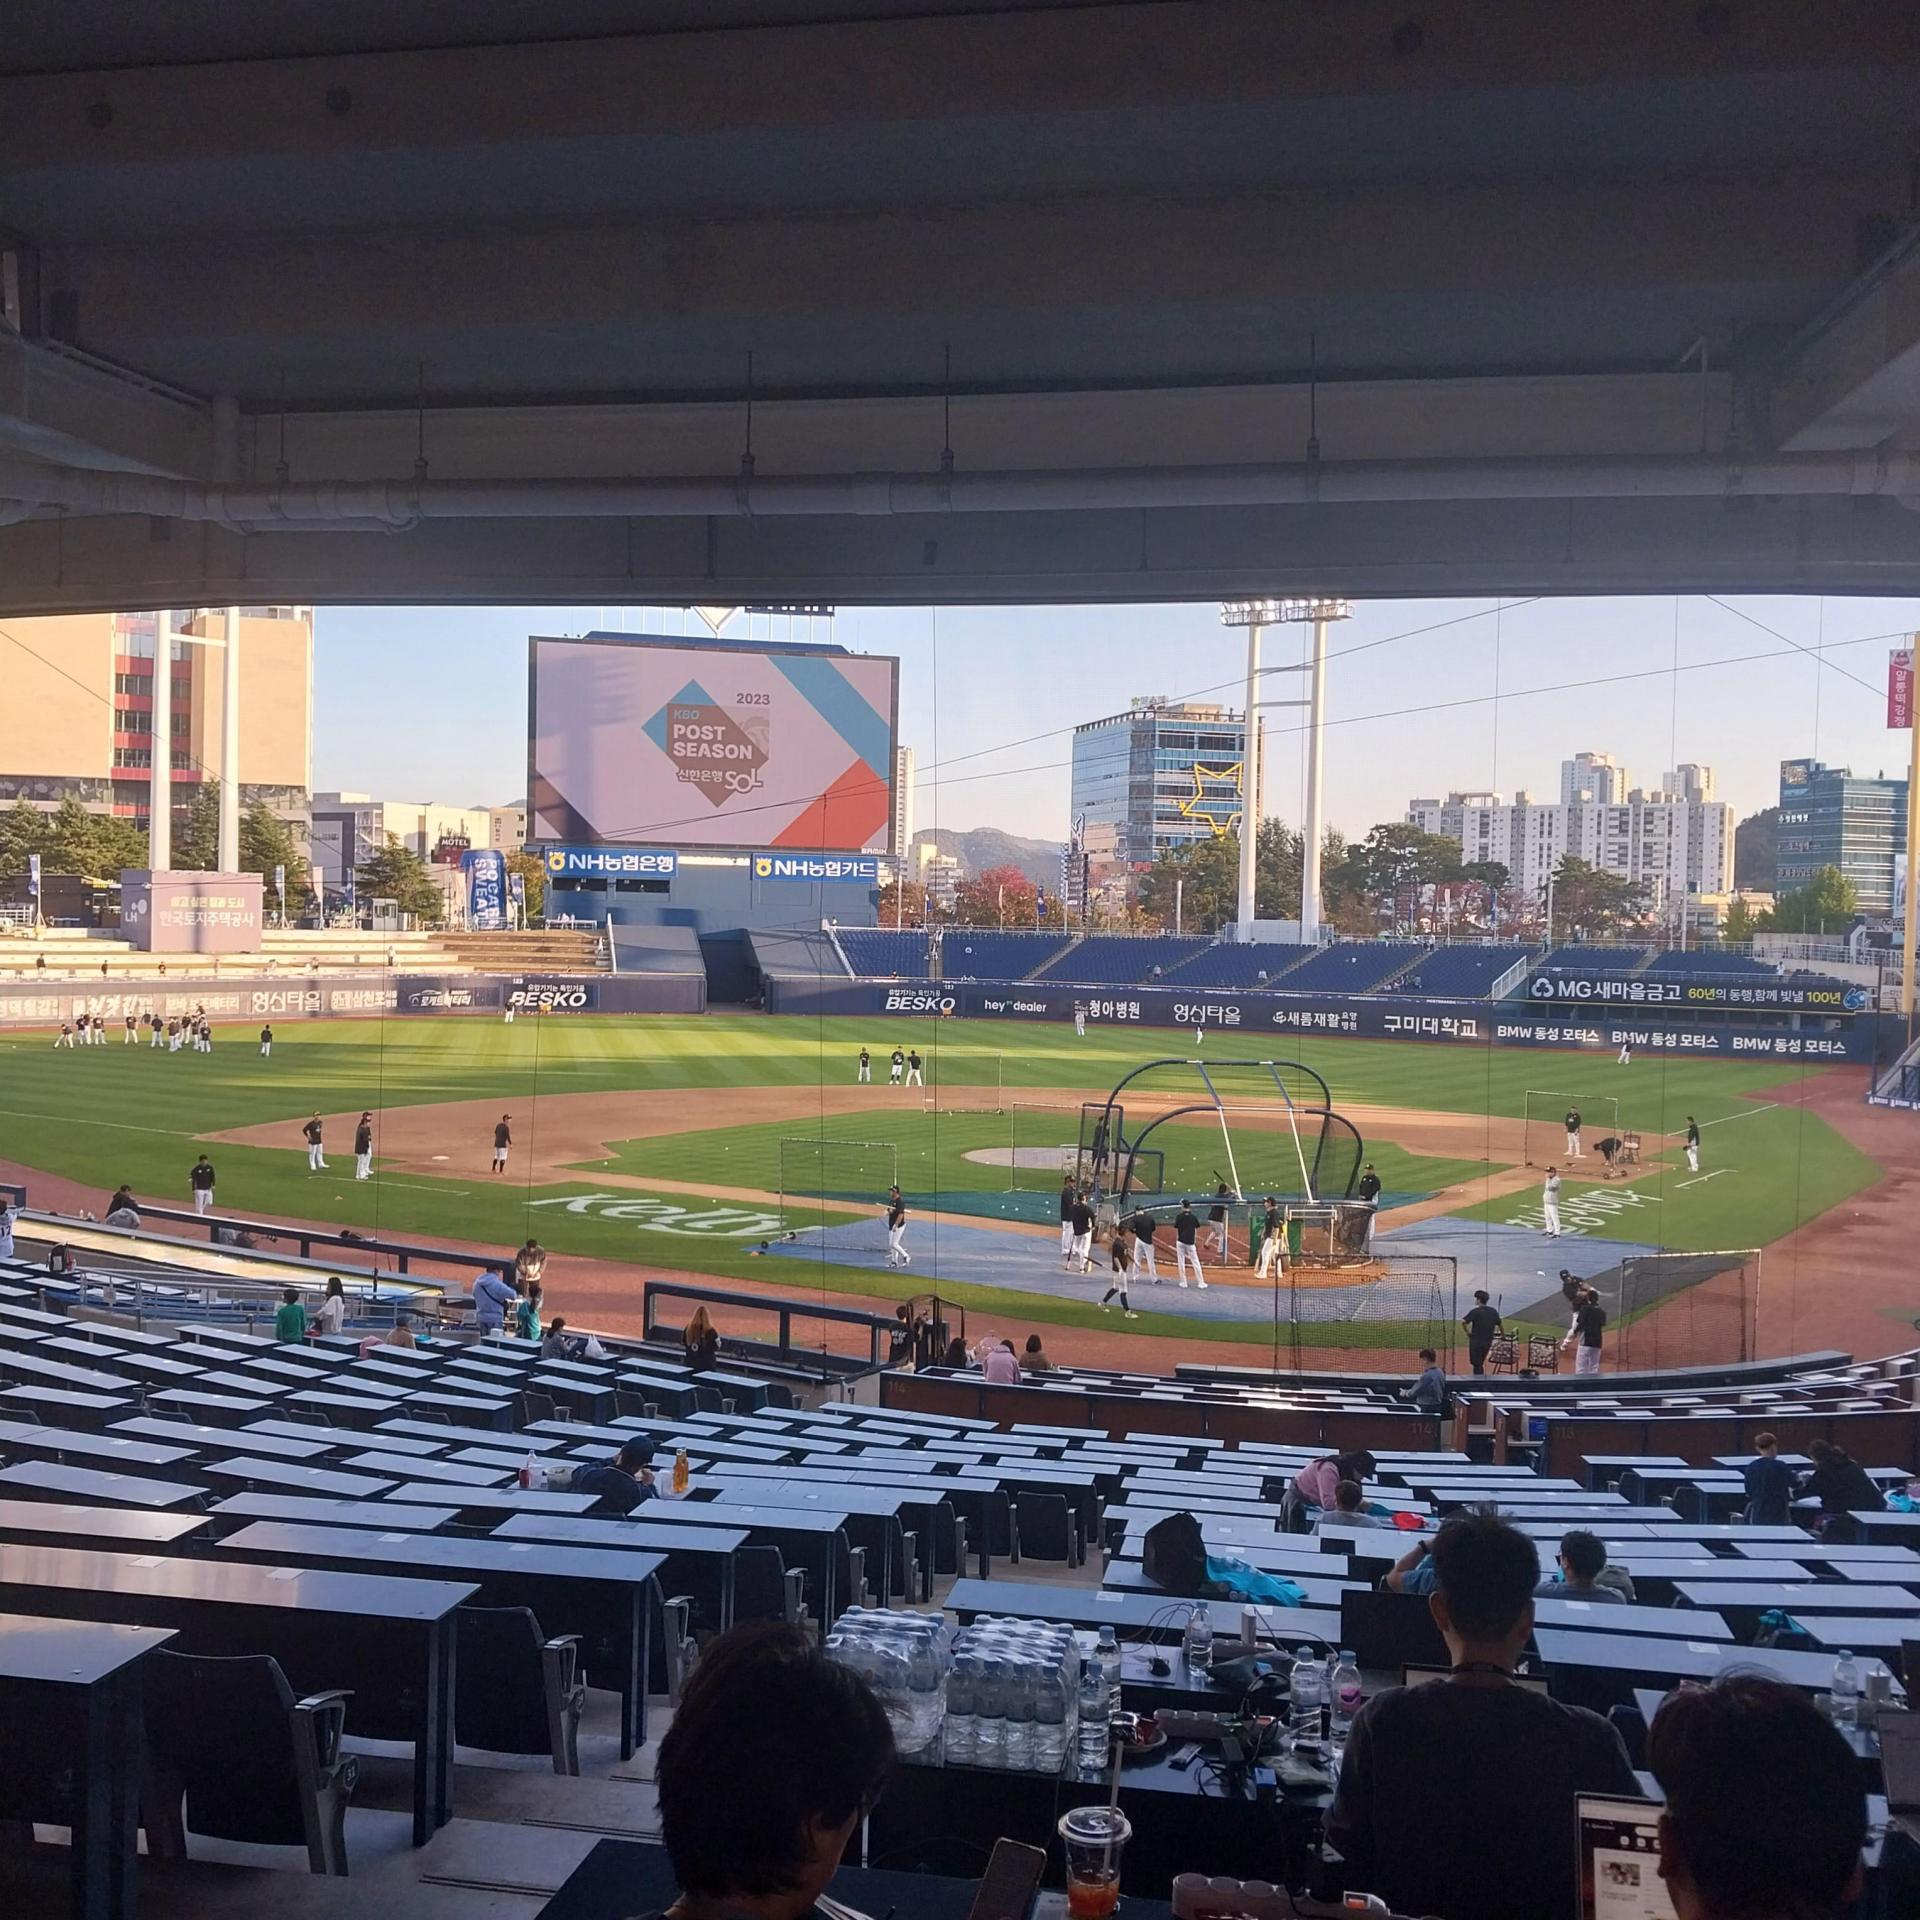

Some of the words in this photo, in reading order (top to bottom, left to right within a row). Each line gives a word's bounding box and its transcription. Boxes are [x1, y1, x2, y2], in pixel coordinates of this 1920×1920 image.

[736, 692, 770, 705] 2023
[673, 710, 700, 720] KBO
[673, 724, 726, 740] POST
[672, 742, 753, 760] SEASON
[678, 768, 723, 783] 신한은행
[441, 838, 468, 846] MOTEL
[569, 852, 674, 873] NH농협은행
[774, 859, 875, 877] NH농협카드
[125, 911, 138, 923] LH
[159, 911, 254, 928] 한국토지주택공사
[252, 990, 322, 1013] 영신타올
[509, 991, 587, 1007] BESKO
[885, 996, 956, 1011] BESKO
[1688, 988, 1726, 1000] 60년의
[1781, 990, 1804, 1003] 빛낼
[1807, 991, 1841, 1005] 100년
[984, 999, 1005, 1012] hey
[1013, 1000, 1047, 1013] dealer
[1089, 999, 1141, 1019] 청아병원
[1174, 1003, 1241, 1025] 영신타올
[1384, 1014, 1478, 1037] 구미대학교
[1498, 1025, 1532, 1038] BMW
[1534, 1027, 1560, 1041] 동성
[1562, 1028, 1600, 1042] 모터스
[1612, 1031, 1648, 1044] BMW
[1651, 1032, 1677, 1047] 동성
[1680, 1033, 1720, 1048] 모터스
[1733, 1037, 1771, 1050] BMW
[1774, 1038, 1801, 1053] 동성
[1804, 1040, 1847, 1055] 모터스
